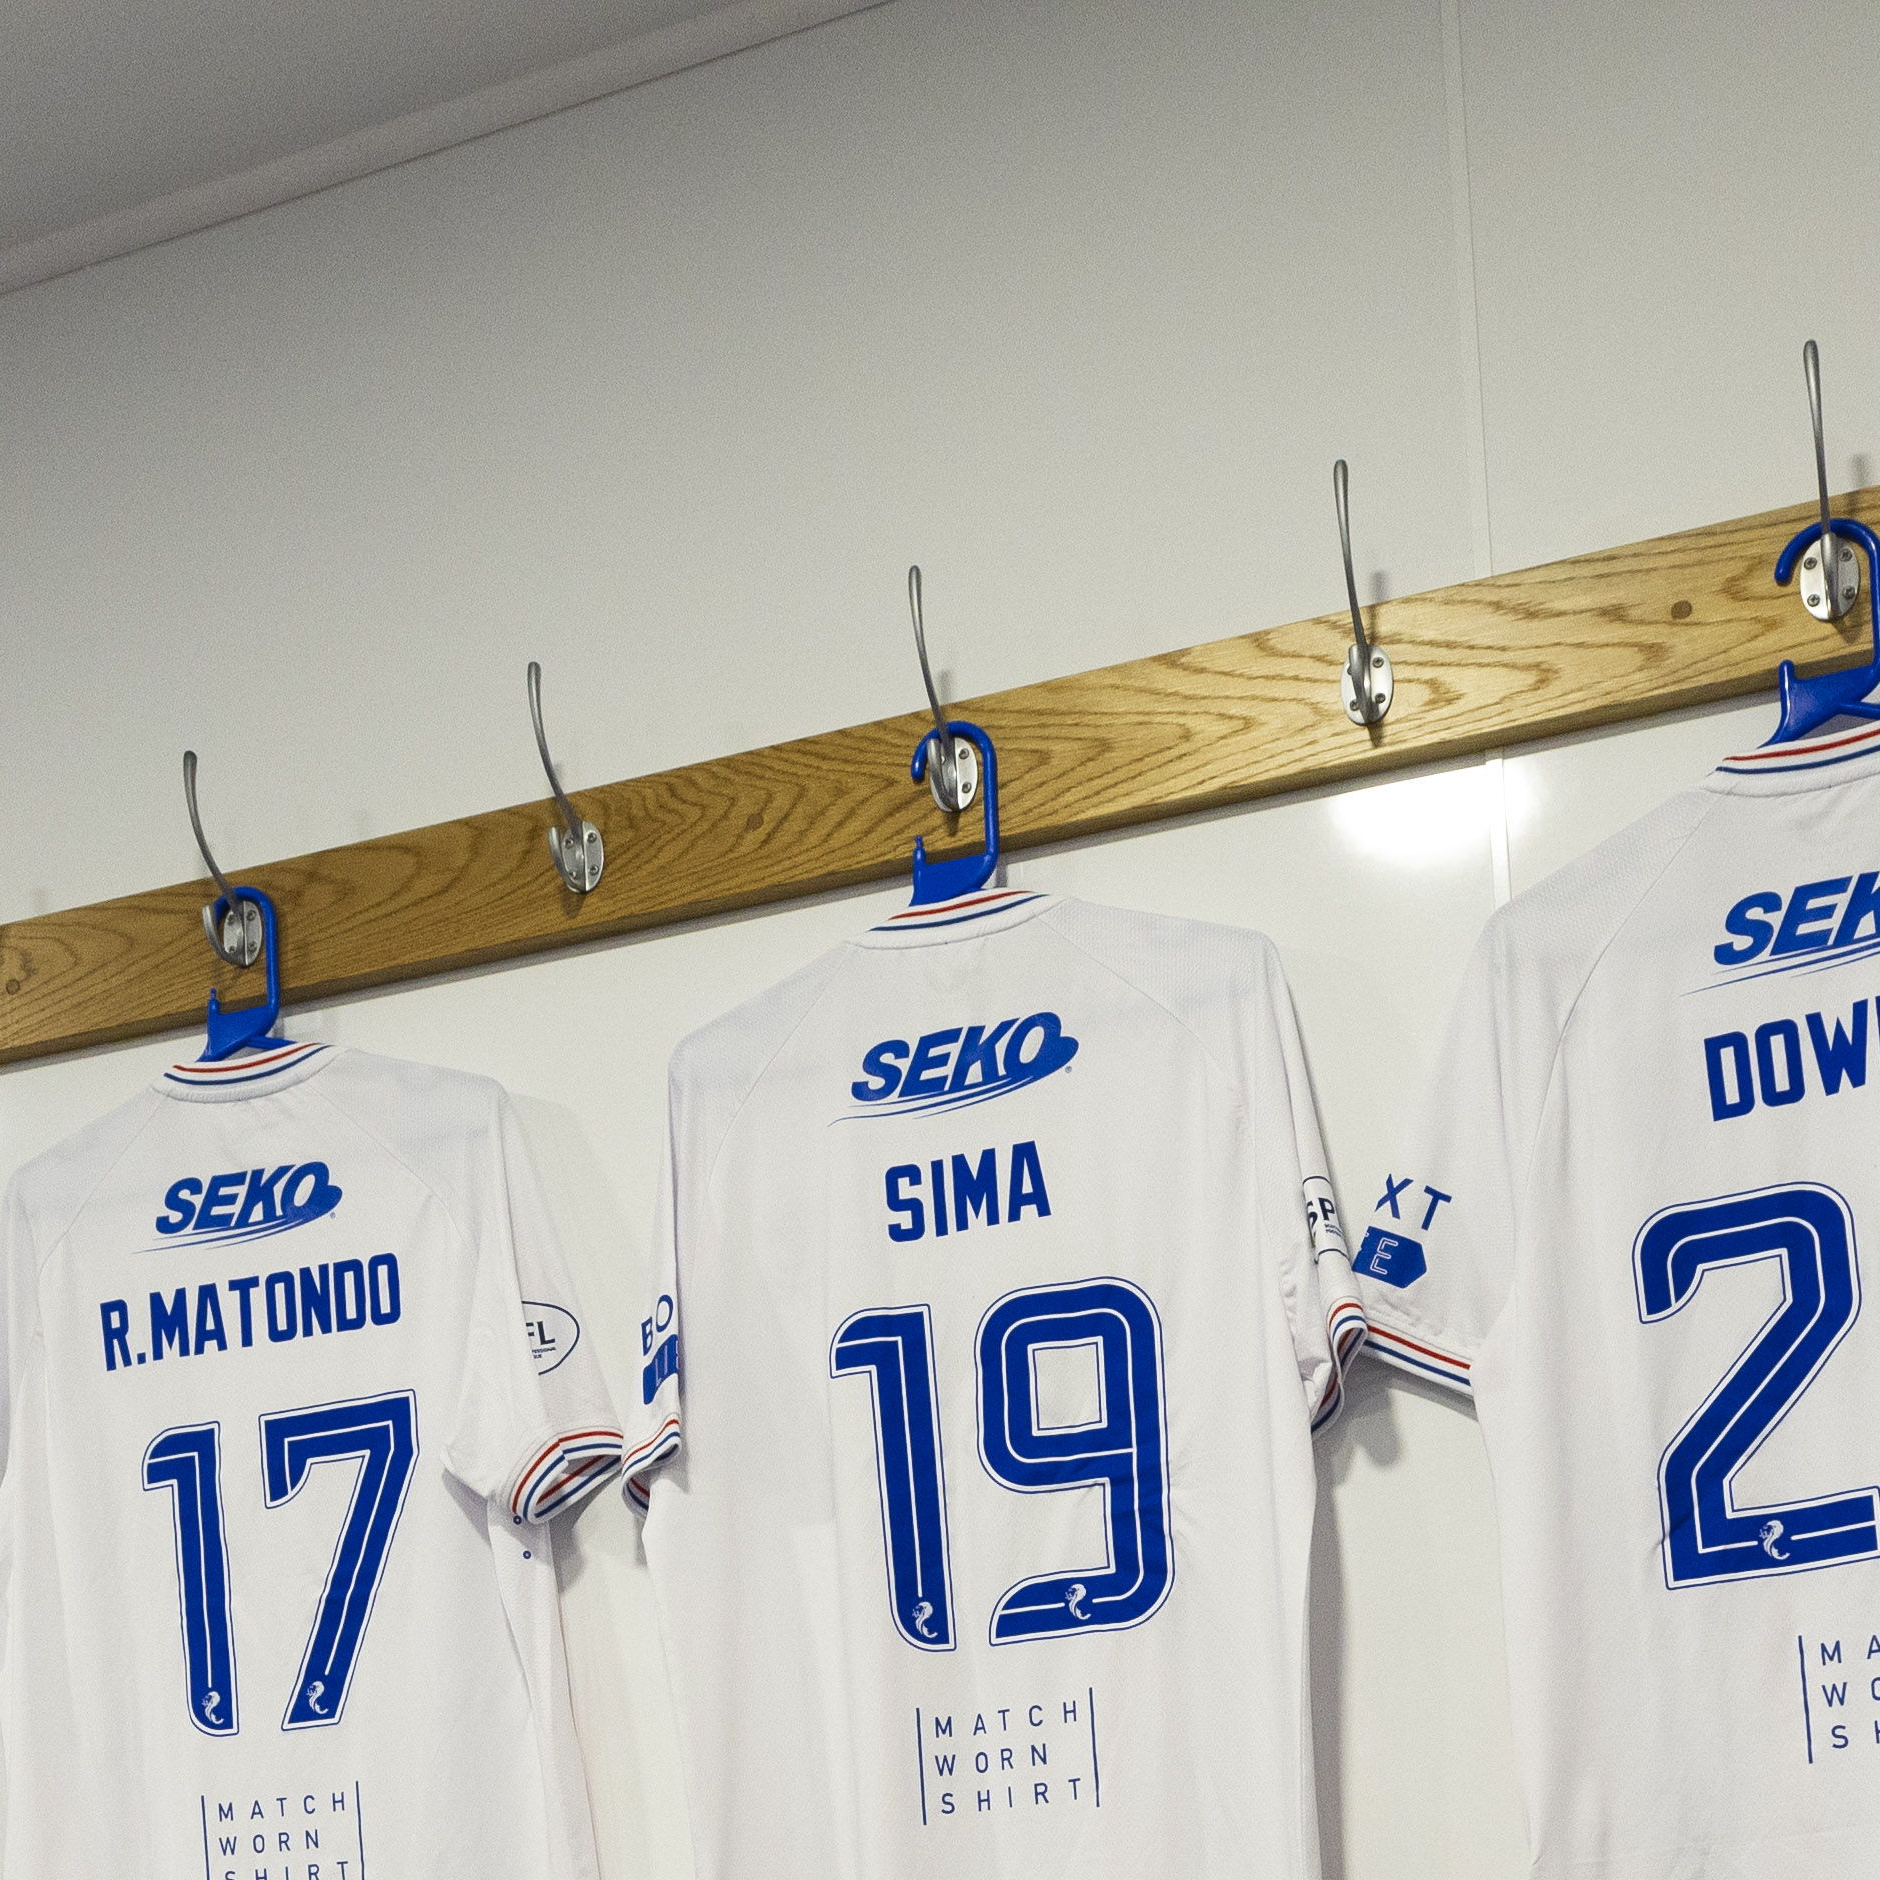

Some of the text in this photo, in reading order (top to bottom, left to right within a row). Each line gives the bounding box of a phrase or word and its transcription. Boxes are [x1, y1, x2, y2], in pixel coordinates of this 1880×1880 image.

[850, 1011, 1079, 1103] SEKO
[155, 1161, 343, 1233] SEKO
[884, 1140, 1052, 1243] SIMA
[1374, 1173, 1452, 1231] XT
[100, 1251, 402, 1371] R.MATONDO
[641, 1294, 674, 1356] BO
[829, 1274, 1176, 1653] 19
[141, 1388, 419, 1738] 17
[934, 1700, 1081, 1739] MATCH
[934, 1743, 1050, 1778] WORN
[218, 1791, 348, 1822] MATCH
[940, 1777, 1083, 1815] SHIRT
[219, 1829, 321, 1857] WORN
